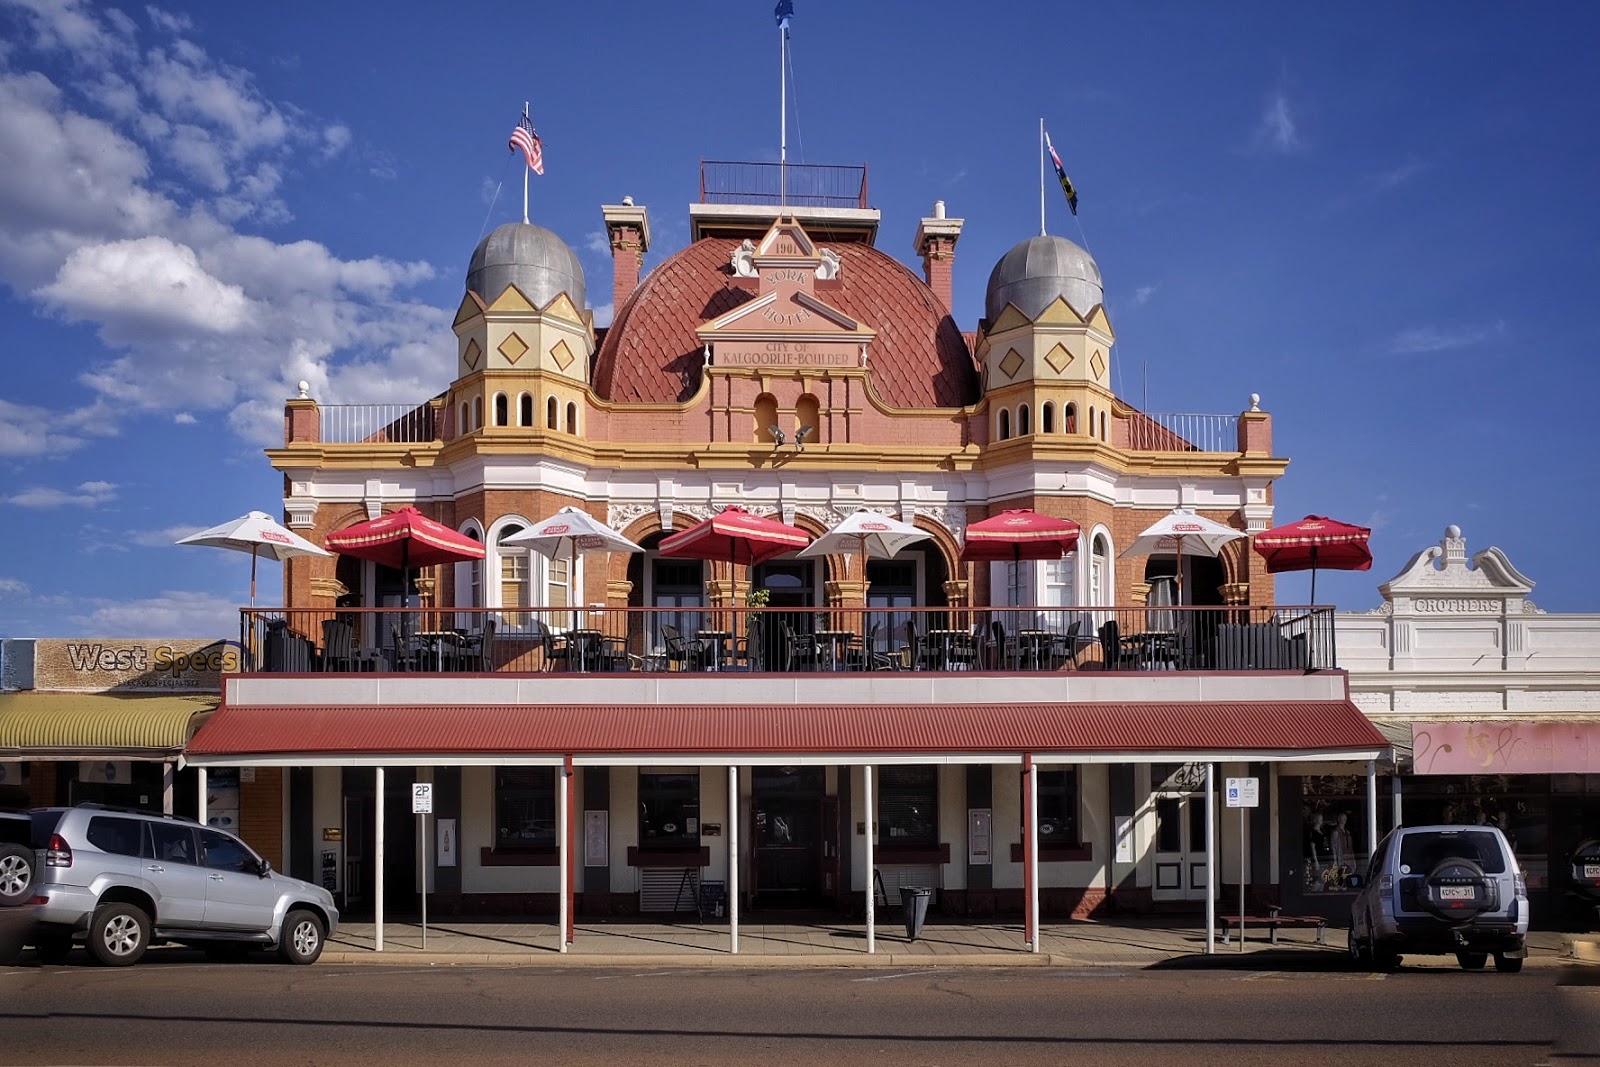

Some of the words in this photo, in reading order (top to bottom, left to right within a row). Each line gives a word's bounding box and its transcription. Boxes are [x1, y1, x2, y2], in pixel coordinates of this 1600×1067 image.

[776, 243, 797, 254] 1901
[765, 269, 807, 285] YORK
[762, 306, 814, 326] HOTEL
[766, 343, 789, 352] CITY
[794, 343, 809, 352] OF
[723, 352, 849, 365] KALGOORLIE-BOULDER
[66, 643, 147, 671] West
[154, 646, 237, 678] Specs
[416, 786, 430, 796] 2P
